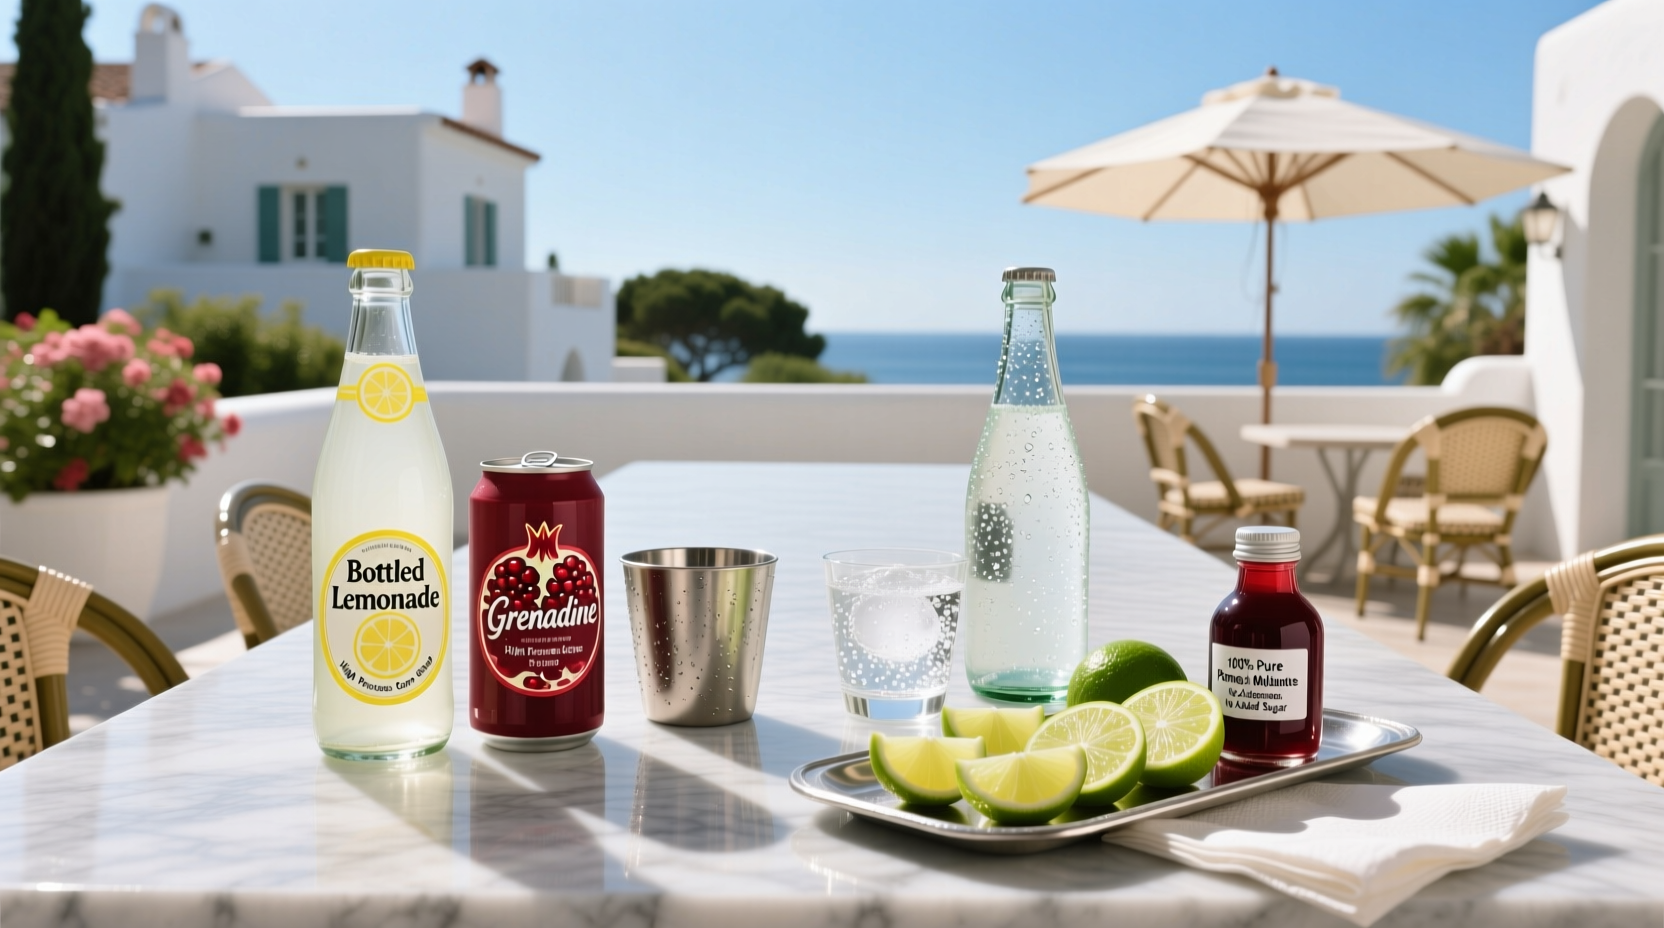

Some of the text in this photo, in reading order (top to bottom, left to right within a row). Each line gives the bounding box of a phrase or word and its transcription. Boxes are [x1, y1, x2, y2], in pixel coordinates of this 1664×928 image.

[347, 557, 424, 583] Bottled
[332, 584, 440, 610] Lemonade
[487, 595, 598, 640] Grenadine
[1227, 657, 1284, 672] 100% Pure
[1263, 702, 1287, 714] Sugar
